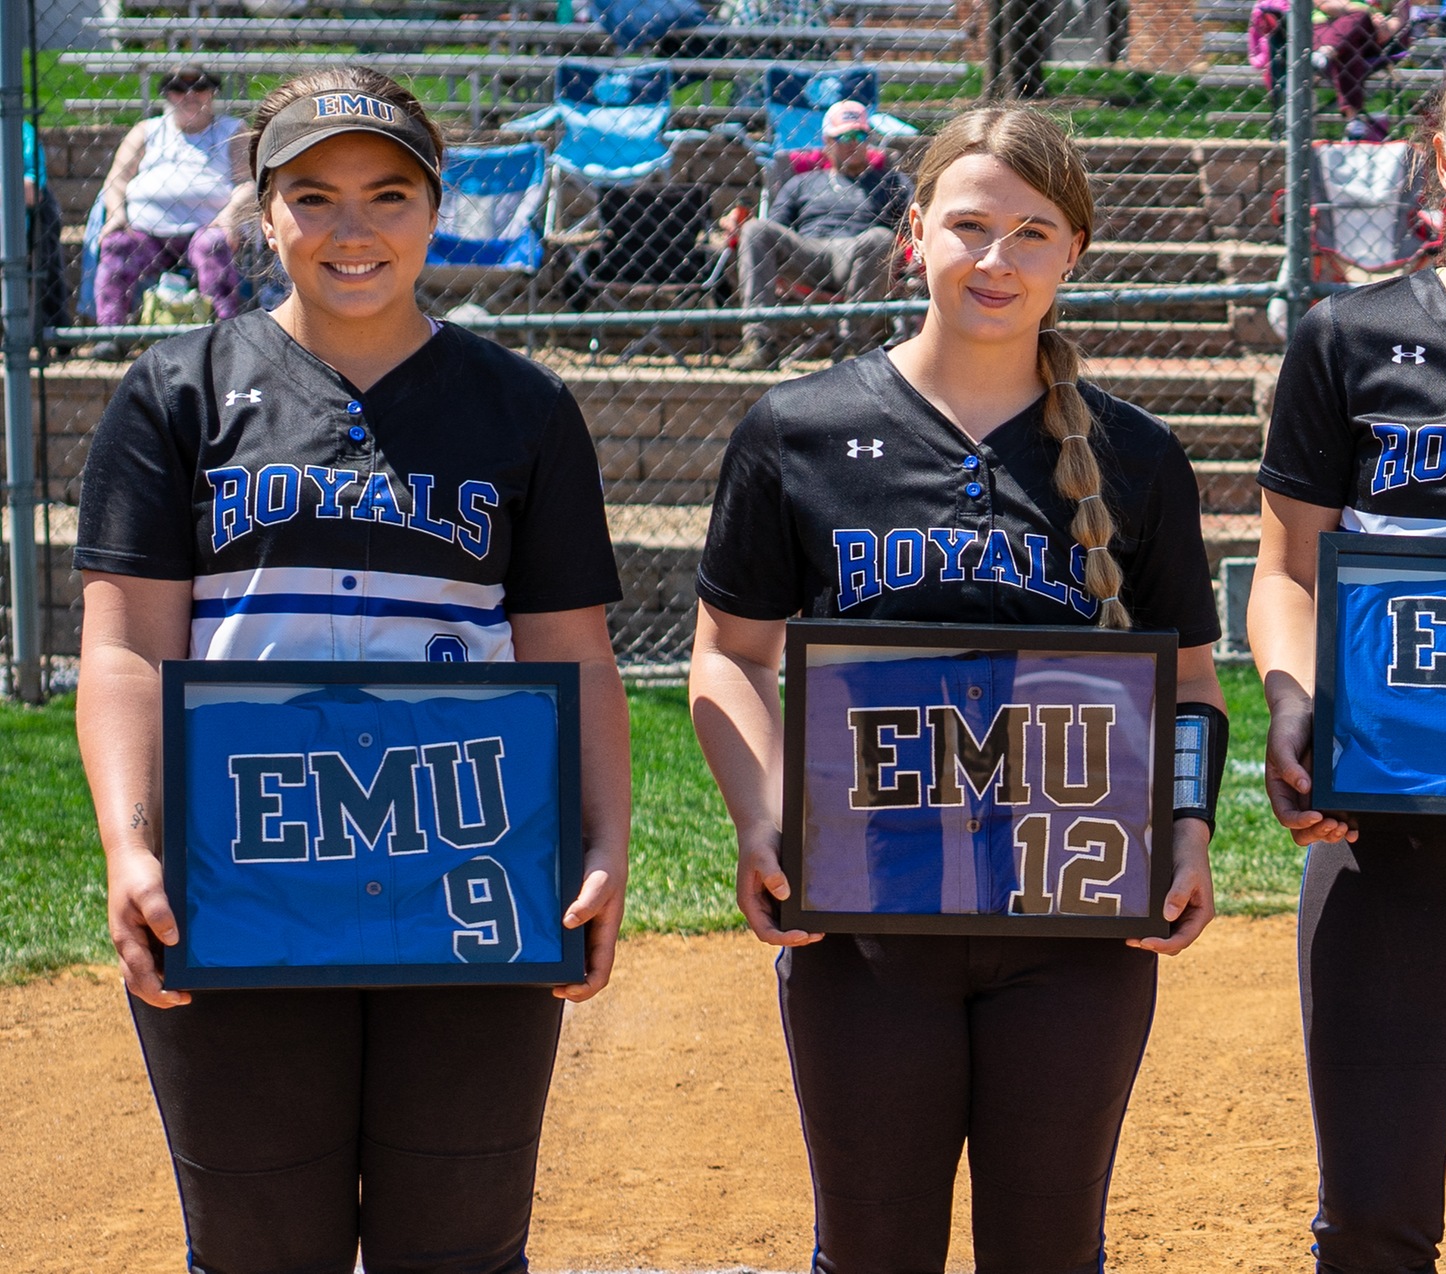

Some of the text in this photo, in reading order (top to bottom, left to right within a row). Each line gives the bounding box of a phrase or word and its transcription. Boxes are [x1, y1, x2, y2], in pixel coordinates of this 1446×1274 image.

[312, 93, 395, 123] EMU
[206, 464, 499, 560] ROYALS
[228, 736, 511, 863] EMU
[847, 703, 1116, 810] EMU
[443, 855, 522, 963] 9
[1008, 813, 1129, 916] 12
